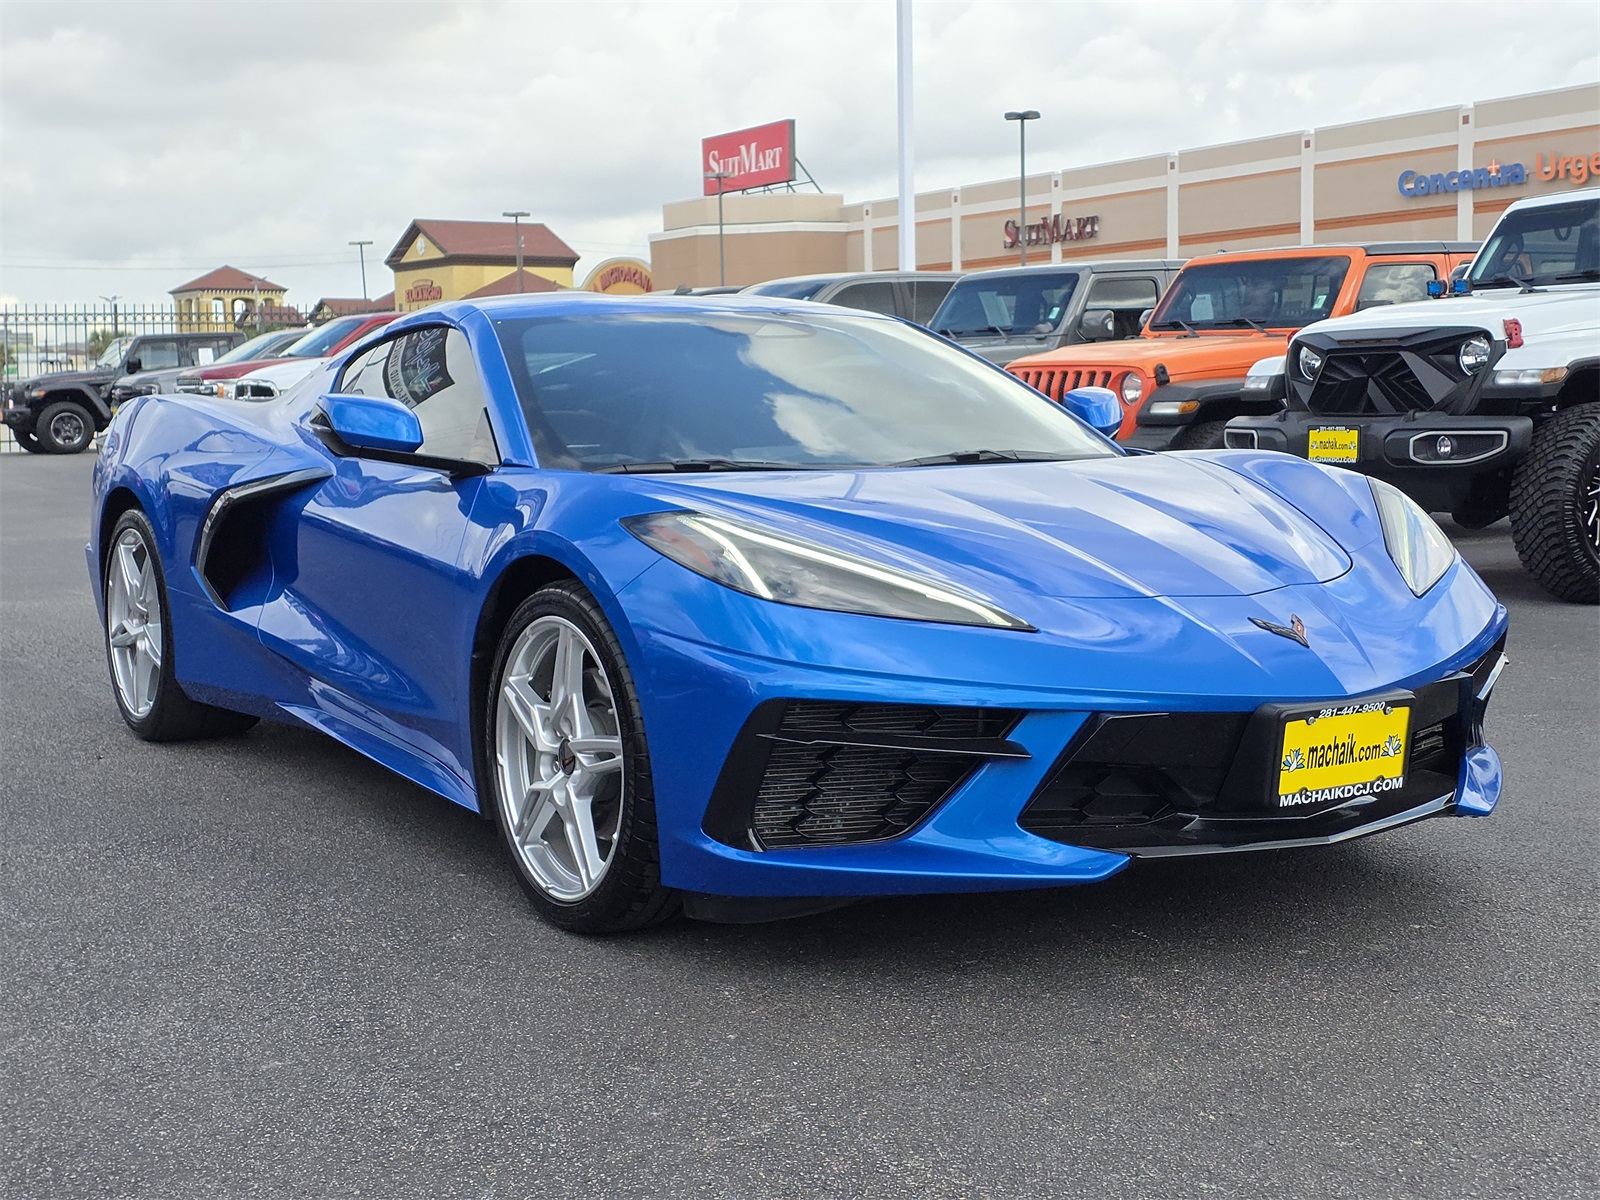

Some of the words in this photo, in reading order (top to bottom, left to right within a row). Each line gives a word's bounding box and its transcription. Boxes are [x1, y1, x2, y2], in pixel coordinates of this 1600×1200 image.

[1398, 158, 1525, 198] Concentra
[1318, 701, 1386, 719] 281-447-9500
[1306, 733, 1382, 770] machaik.com
[1279, 776, 1404, 808] MACHAIKDCJ.COM
